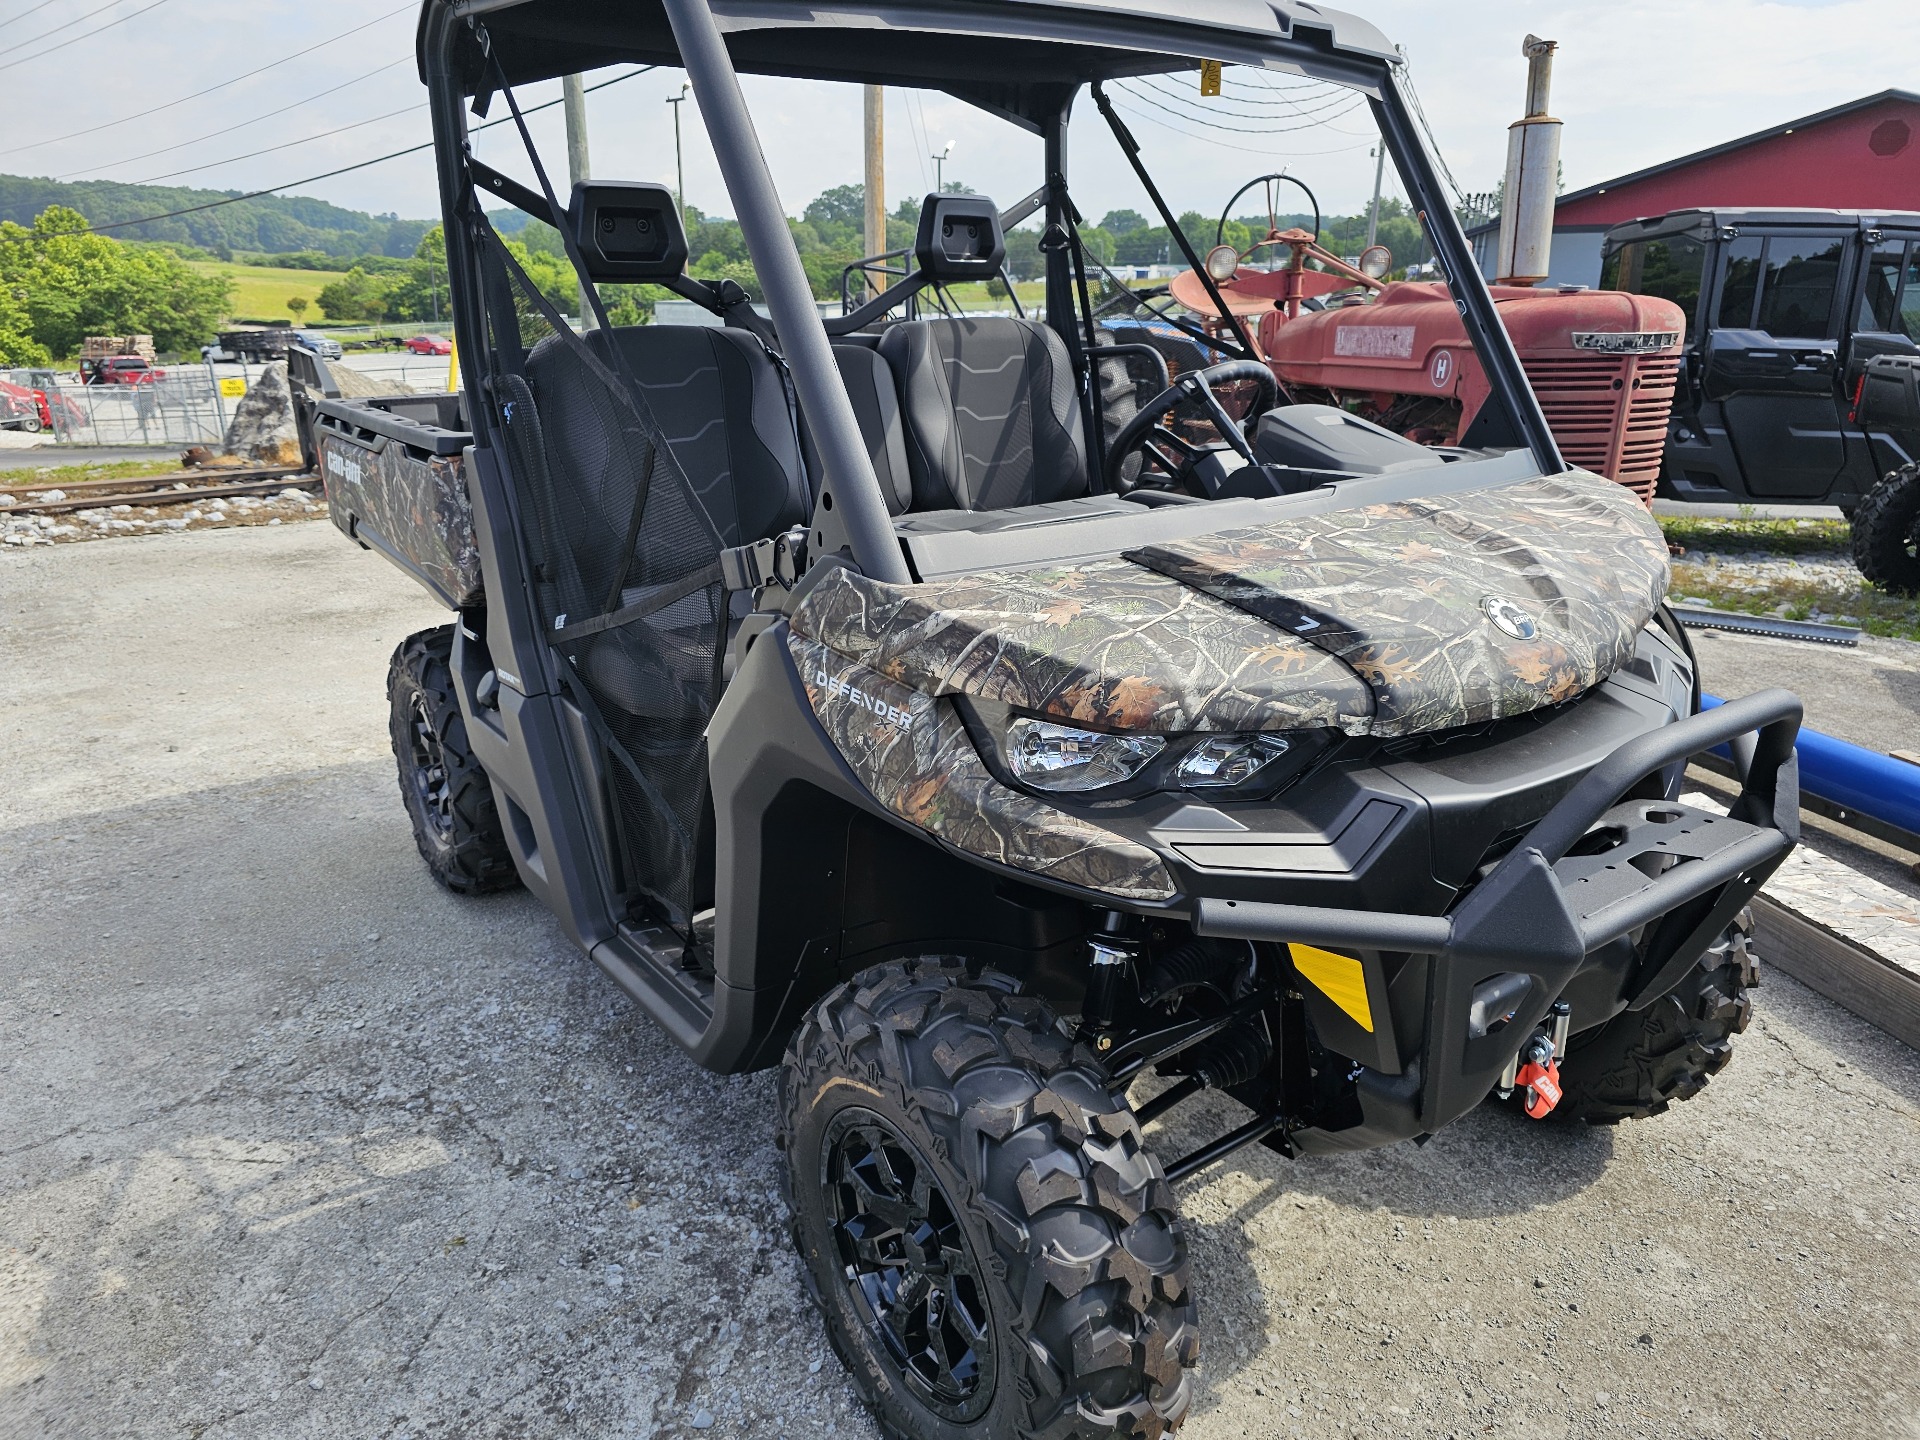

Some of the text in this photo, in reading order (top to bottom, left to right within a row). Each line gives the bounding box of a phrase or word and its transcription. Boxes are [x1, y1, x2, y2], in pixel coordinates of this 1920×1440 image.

[1435, 358, 1447, 379] H
[1513, 614, 1531, 625] BRP
[816, 670, 913, 730] DEFENDER
